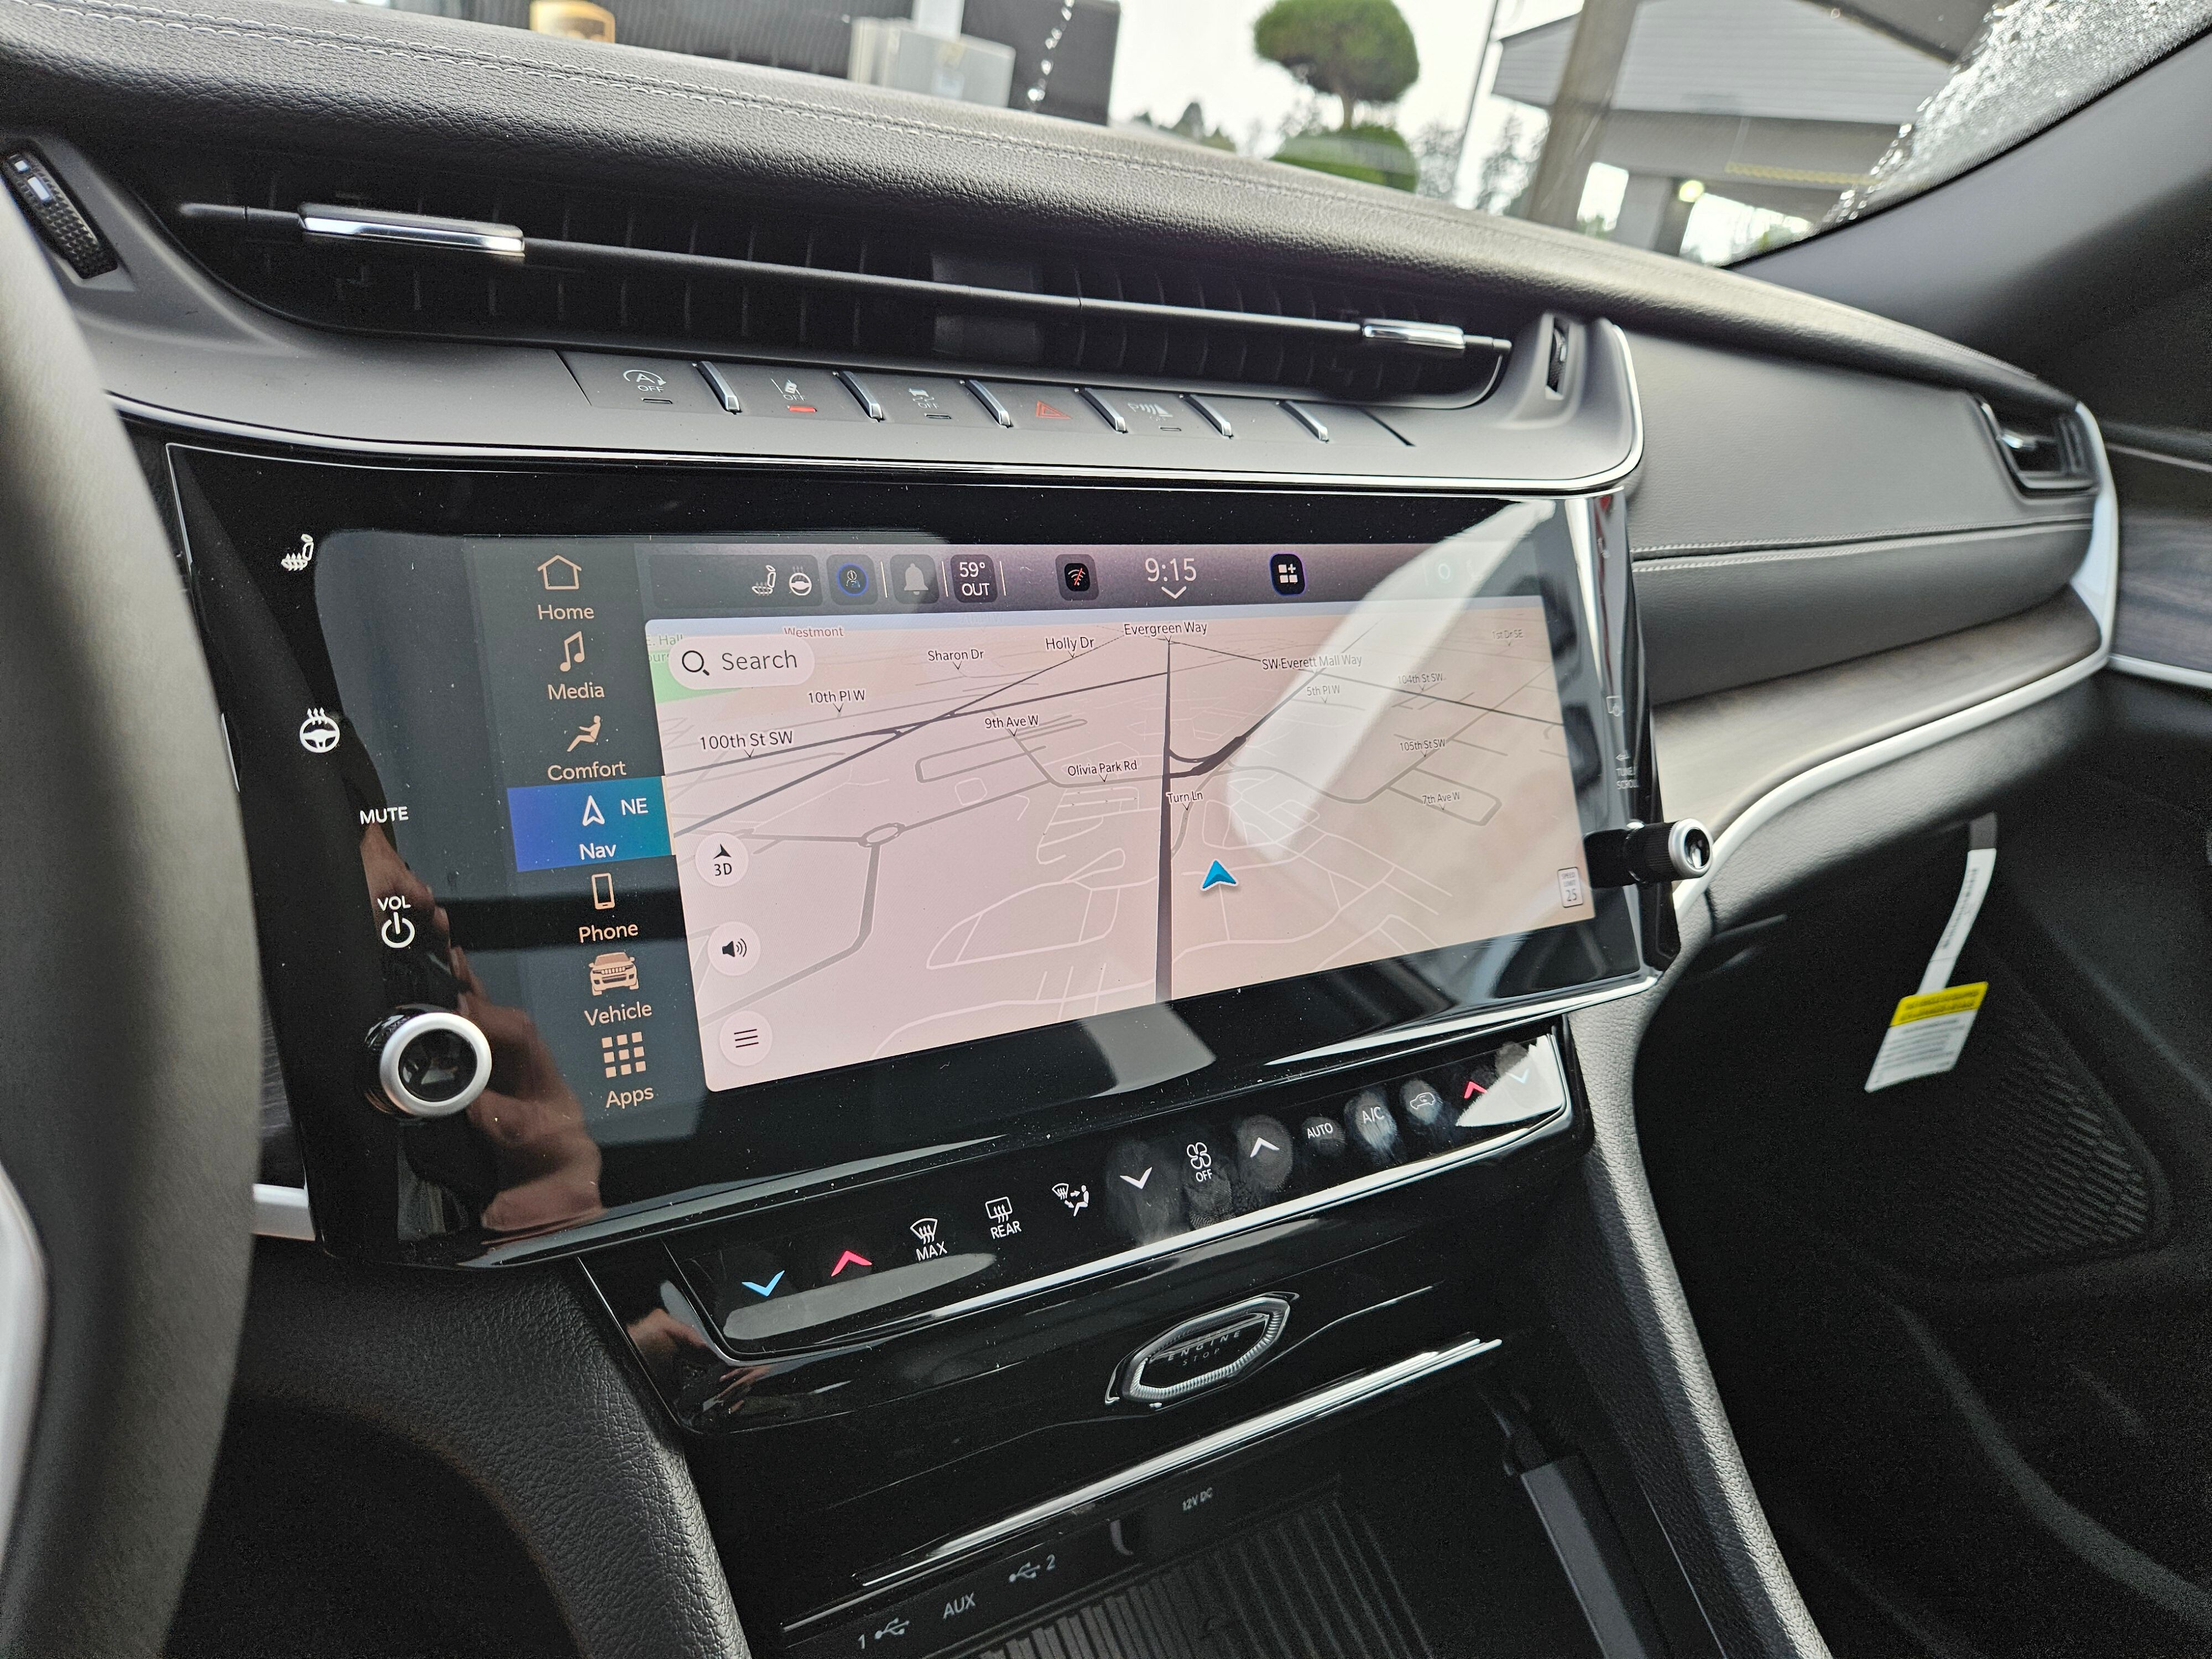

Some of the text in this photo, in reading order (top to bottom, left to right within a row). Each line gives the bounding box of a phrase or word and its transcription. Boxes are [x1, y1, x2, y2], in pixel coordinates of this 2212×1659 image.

[959, 561, 985, 578] 59°
[1145, 557, 1197, 582] 9:15
[961, 582, 990, 597] OUT
[538, 604, 594, 620] Home
[784, 627, 844, 637] Westmont
[1123, 621, 1208, 637] Evergreen Way
[1046, 637, 1094, 651] Holly Dr
[721, 649, 797, 671] Search
[927, 649, 984, 661] Sharon Dr
[1262, 654, 1362, 670] SW Everett Mall Way
[1398, 672, 1443, 684] 104th St SW
[547, 682, 605, 700] Media
[808, 690, 865, 703] 10th Pl W
[1307, 685, 1340, 696] 5th Pl W
[985, 714, 1039, 729] 9th Ave W
[700, 731, 792, 750] 100th St SW
[1400, 739, 1445, 751] 105th St SW
[547, 761, 627, 781] Comfort
[1067, 760, 1137, 776] Olivia Park Rd
[1167, 791, 1203, 803] Turn Ln
[1422, 791, 1460, 804] 7th Ave W
[621, 797, 649, 815] NE
[359, 806, 409, 825] MUTE
[579, 843, 617, 860] Nav
[714, 863, 732, 877] 3D
[1566, 888, 1577, 901] 25
[377, 895, 411, 911] VOL
[578, 924, 639, 943] Phone
[584, 1001, 653, 1026] Vehicle
[606, 1087, 654, 1108] Apps
[1362, 1106, 1385, 1124] A/C
[1307, 1122, 1334, 1139] AUTO
[1196, 1169, 1213, 1182] OFF
[990, 1220, 1022, 1239] REAR
[916, 1241, 948, 1261] MAX
[1168, 1330, 1241, 1361] ENGINE
[1183, 1348, 1220, 1365] STOP
[1046, 1554, 1056, 1571] 2
[943, 1592, 976, 1619] AUX
[858, 1634, 865, 1650] 1
